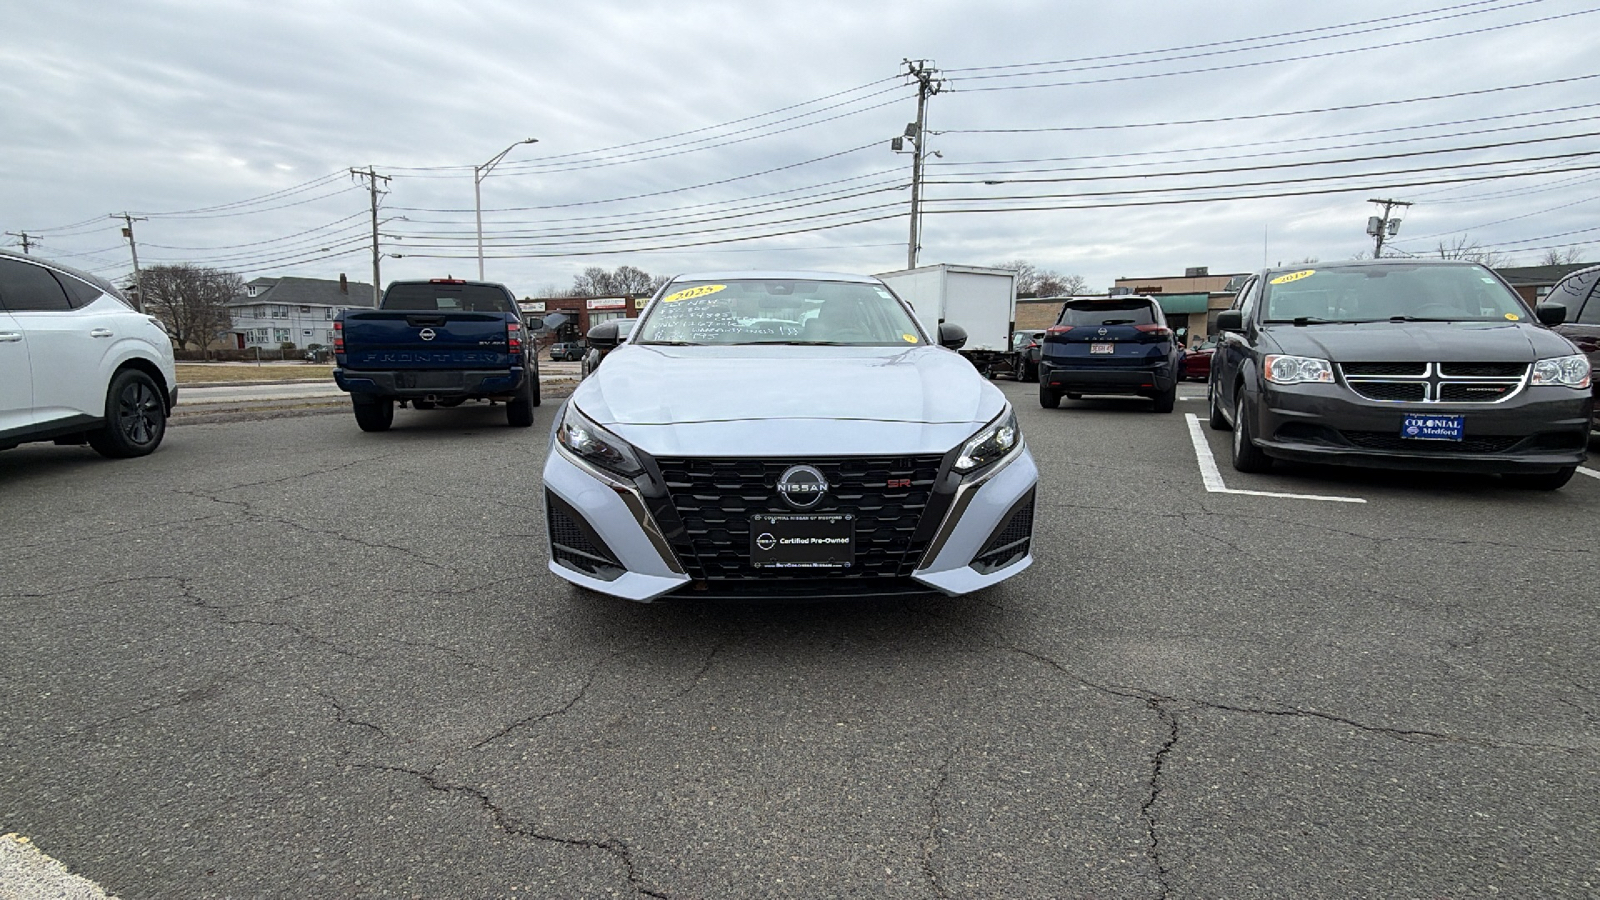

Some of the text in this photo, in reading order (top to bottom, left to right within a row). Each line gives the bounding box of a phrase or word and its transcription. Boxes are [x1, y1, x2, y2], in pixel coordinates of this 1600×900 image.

[1280, 271, 1307, 283] 2019
[674, 287, 714, 300] 2025
[363, 353, 497, 362] FRONTIER
[1405, 418, 1461, 429] COLONIAL
[1423, 427, 1458, 436] Medford
[778, 484, 828, 492] NISSAN
[887, 478, 911, 489] SR
[780, 537, 850, 545] Certified Pre-Owned
